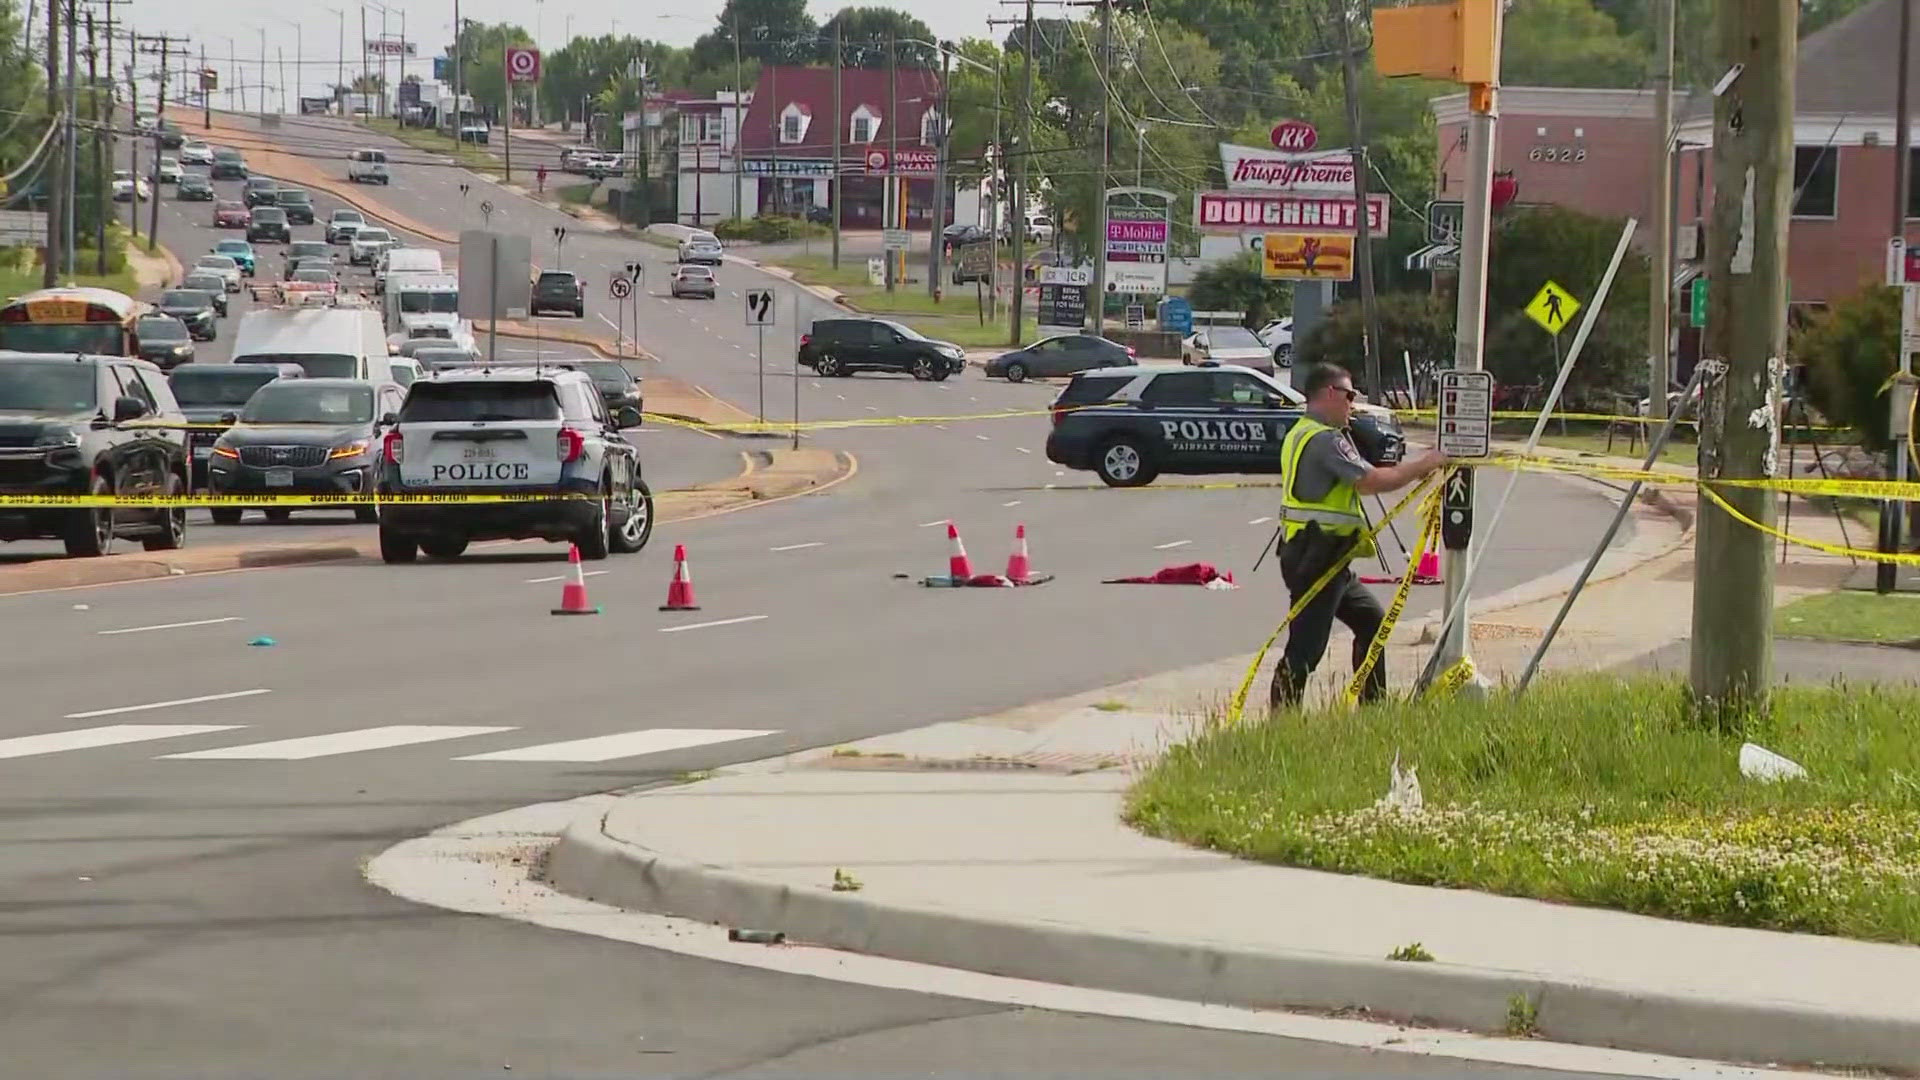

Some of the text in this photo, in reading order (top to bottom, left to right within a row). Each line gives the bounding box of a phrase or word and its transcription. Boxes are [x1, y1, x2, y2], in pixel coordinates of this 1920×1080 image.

[1729, 112, 1743, 136] 4
[1279, 128, 1309, 148] KK
[1529, 149, 1587, 163] 6328
[1232, 158, 1353, 186] Krispy Kreme
[1205, 200, 1377, 227] DOUGHNUTS
[1123, 225, 1163, 240] Mobile
[1160, 420, 1266, 441] POLICE
[1172, 442, 1261, 452] FAIRFAX COUNTY
[432, 463, 529, 481] POLICE
